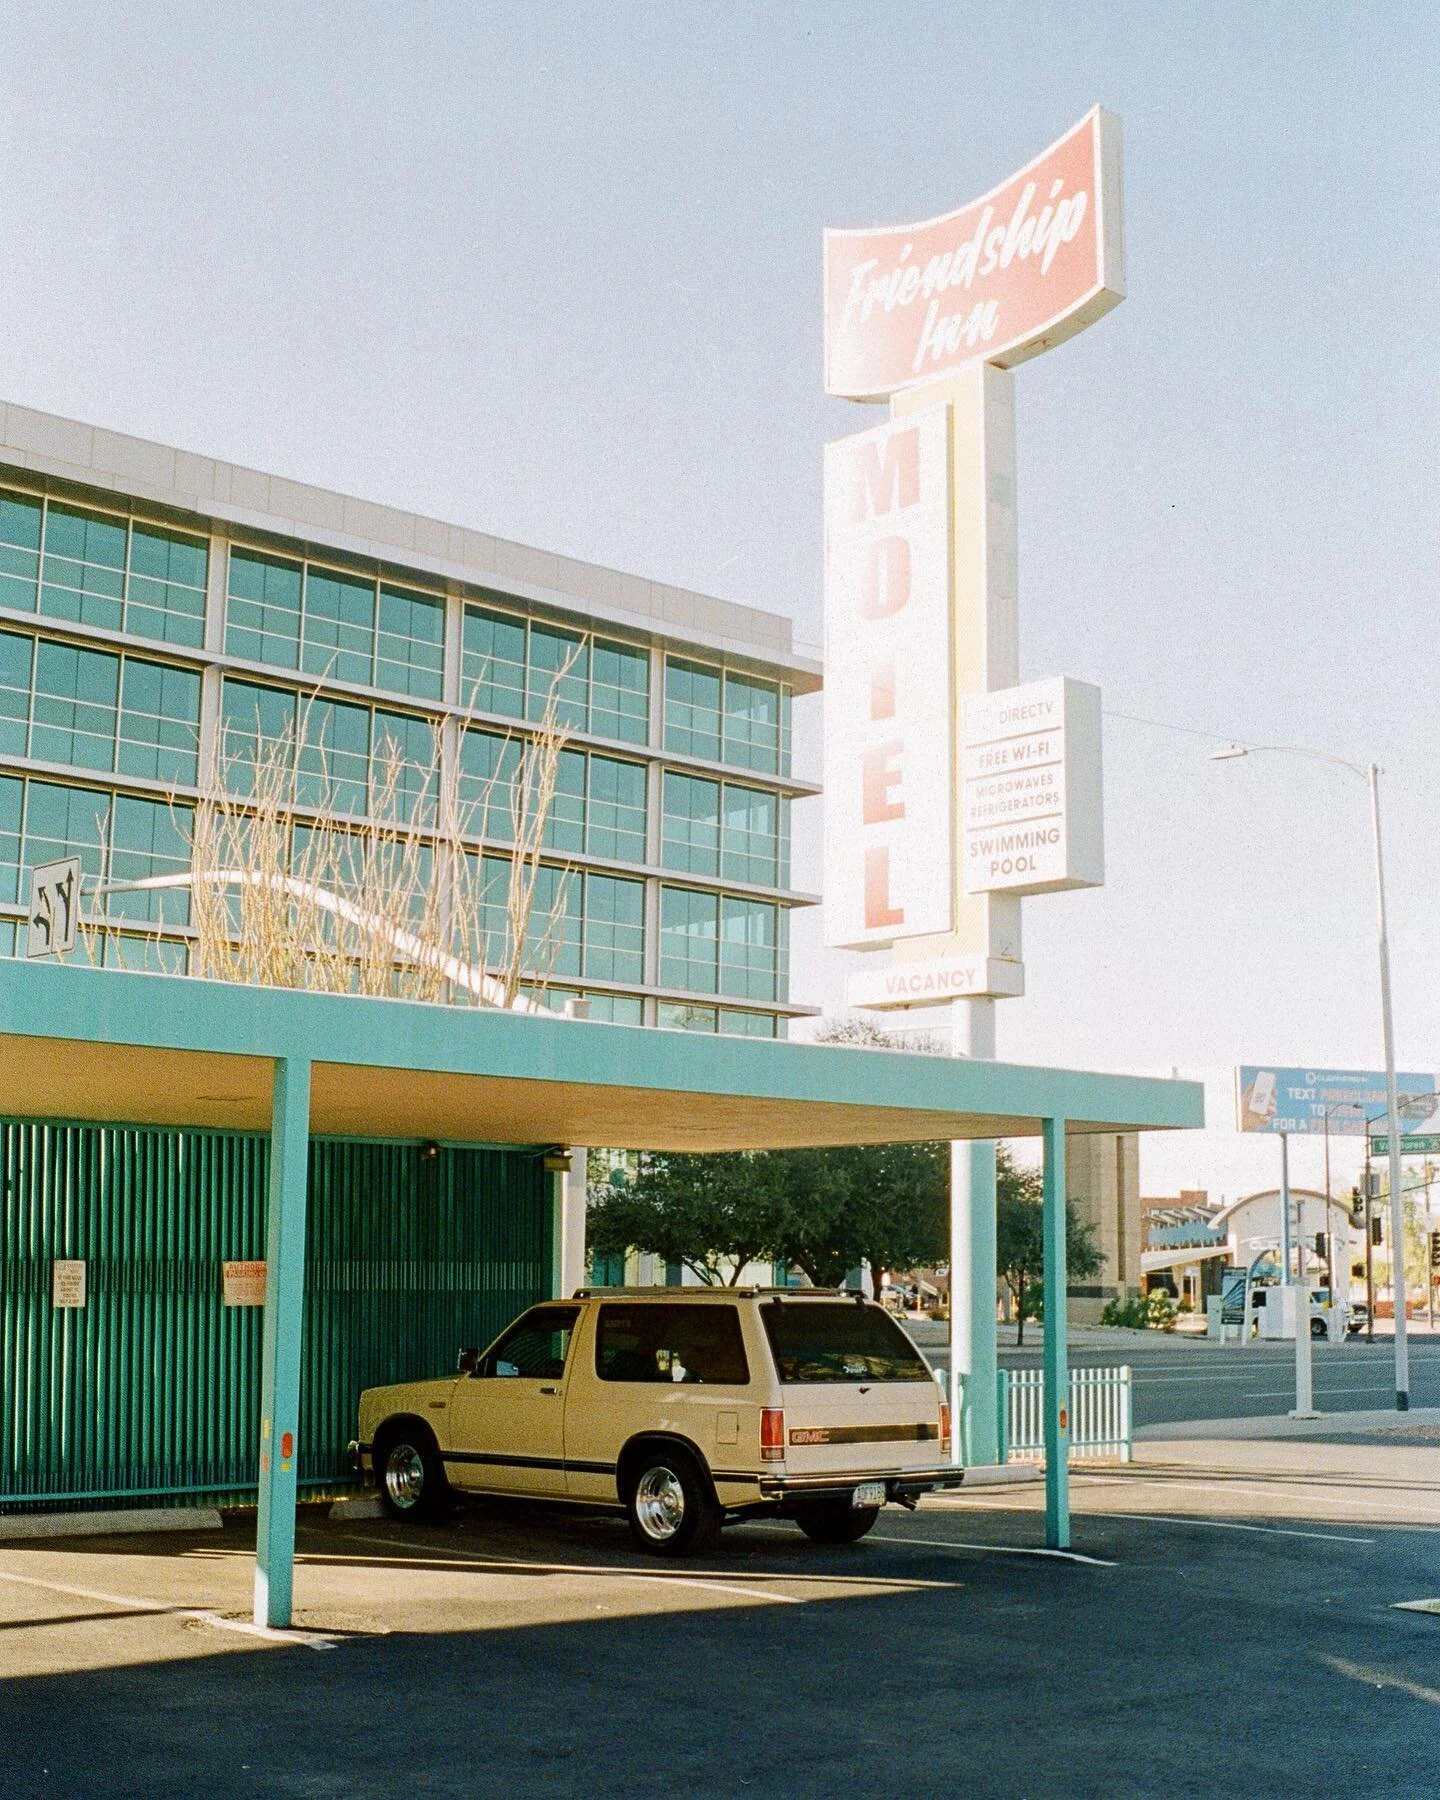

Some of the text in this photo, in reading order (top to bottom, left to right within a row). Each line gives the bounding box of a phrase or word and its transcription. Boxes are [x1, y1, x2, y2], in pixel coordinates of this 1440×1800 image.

[840, 178, 1088, 328] Friendship
[912, 300, 999, 373] Inn
[998, 700, 1054, 724] DIRECTV
[978, 741, 1049, 769] FREE WI-FI
[975, 774, 1053, 797] MICROWAVES
[970, 791, 1060, 818] REFRIGERATORS
[970, 827, 1060, 858] SWIMMING
[990, 855, 1037, 877] POOL
[885, 967, 976, 994] VACANCY
[791, 1430, 830, 1443] GMC
